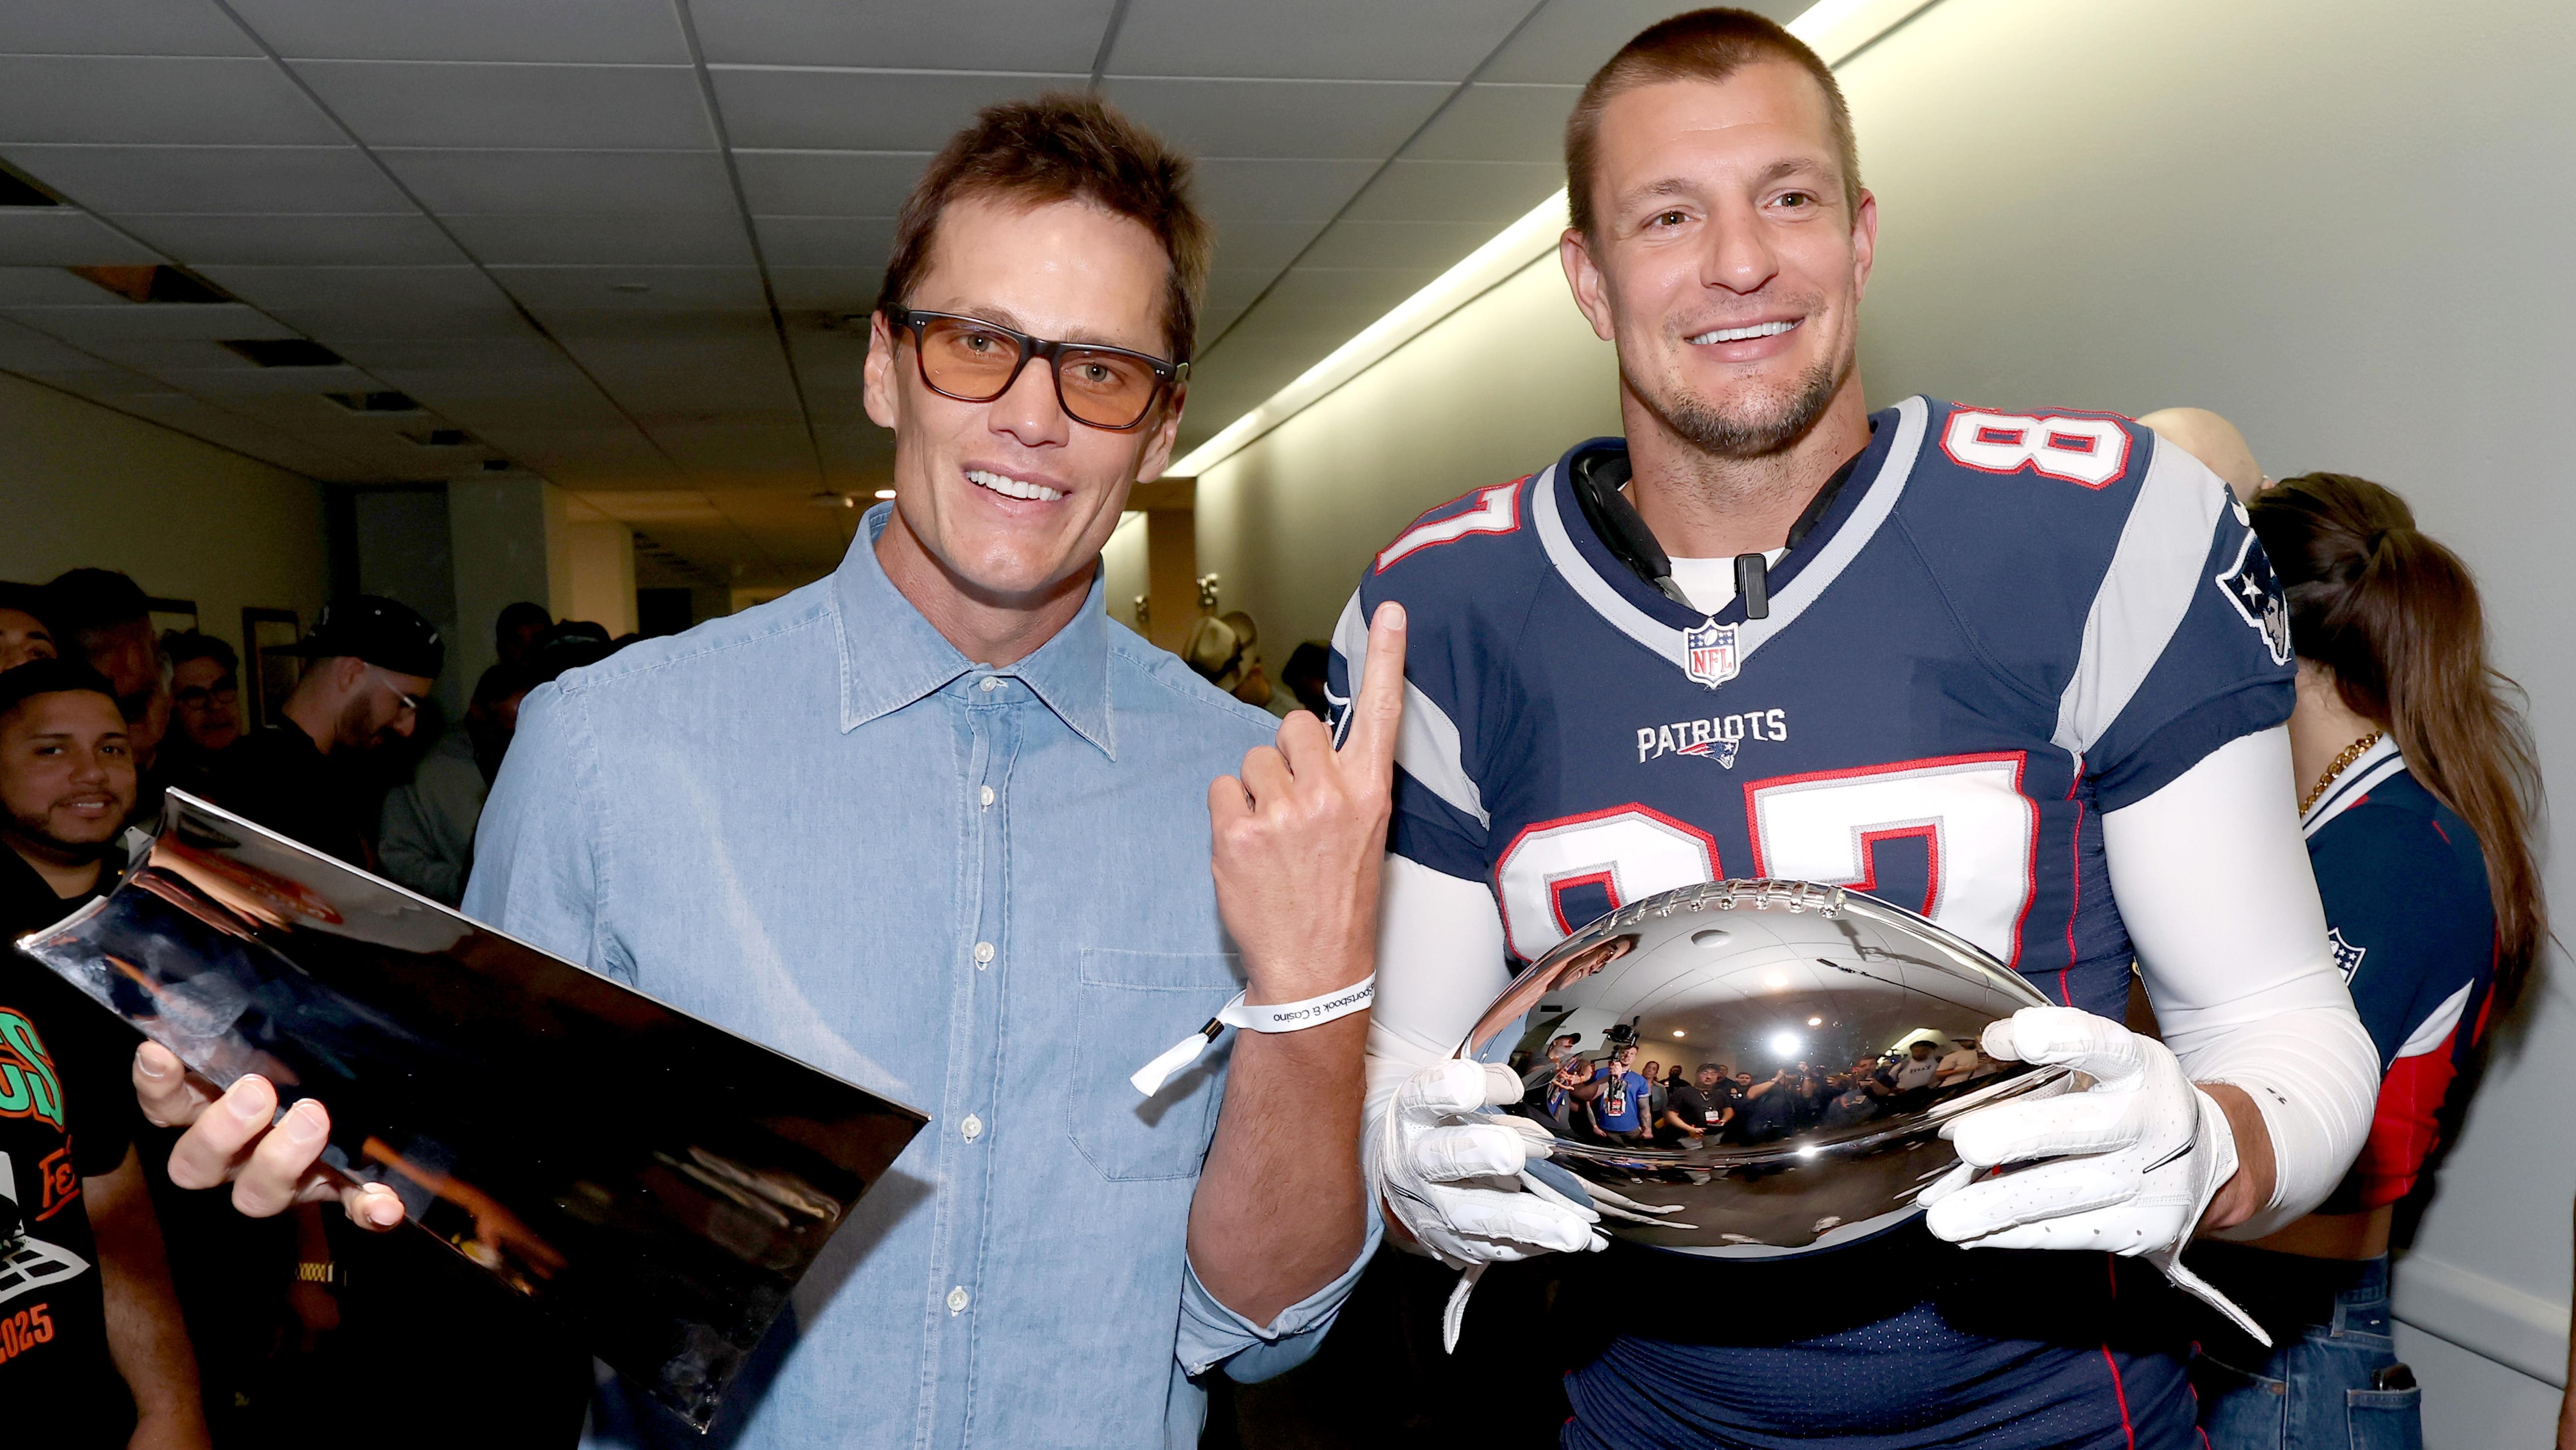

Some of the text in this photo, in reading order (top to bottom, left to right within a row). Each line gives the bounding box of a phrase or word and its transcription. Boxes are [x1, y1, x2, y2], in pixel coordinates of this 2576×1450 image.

[1693, 648, 1733, 676] NFL
[1637, 708, 1788, 764] PATRIOTS
[1274, 1010, 1310, 1022] Casino
[1312, 1006, 1321, 1016] &
[0, 1303, 55, 1364] 025
